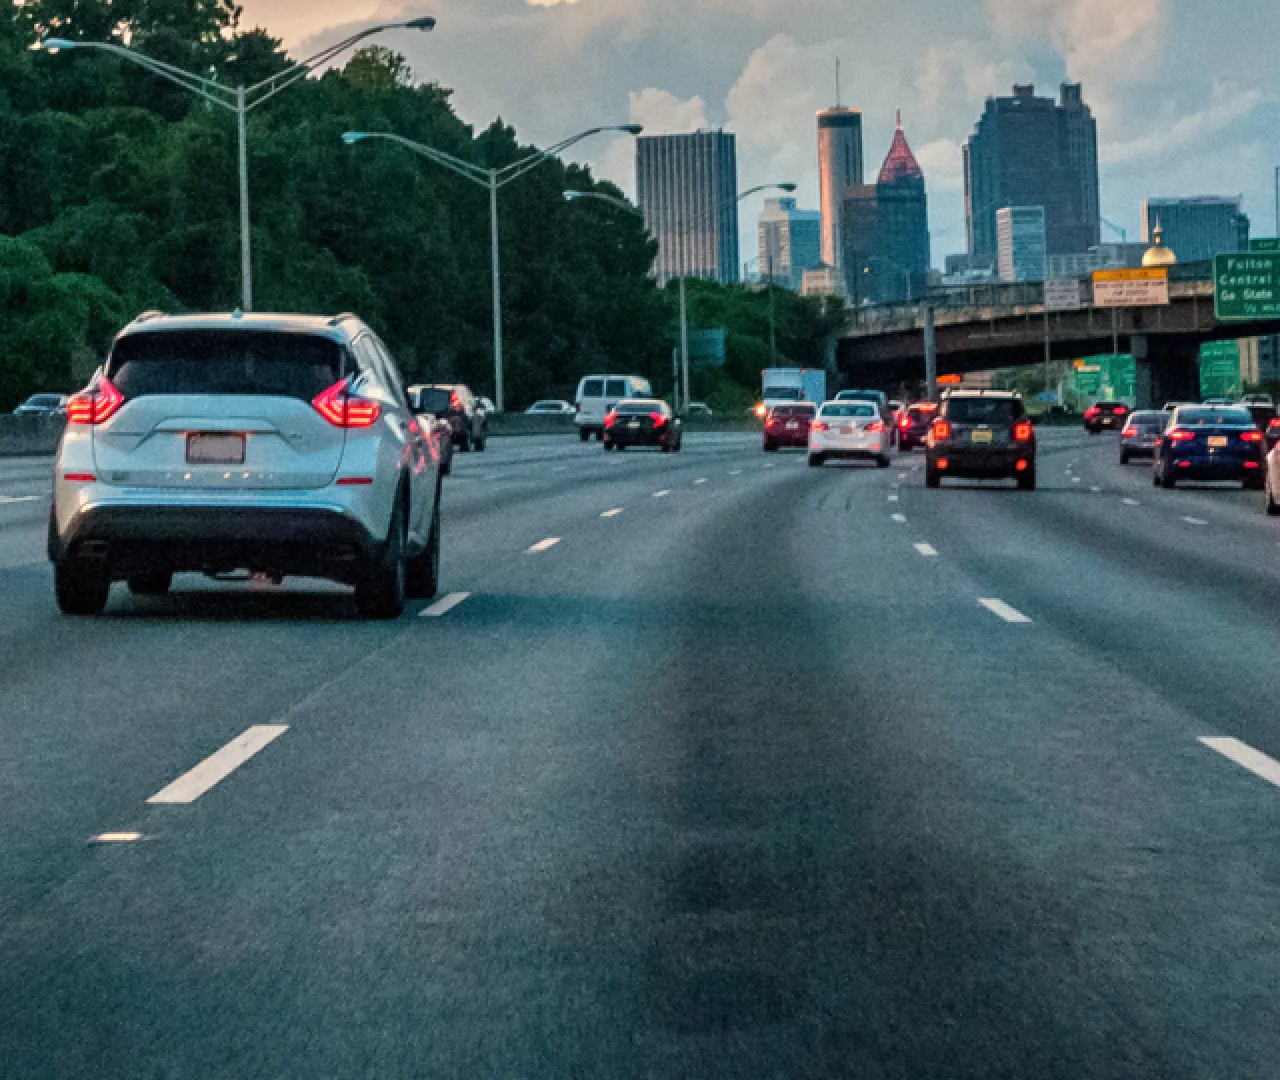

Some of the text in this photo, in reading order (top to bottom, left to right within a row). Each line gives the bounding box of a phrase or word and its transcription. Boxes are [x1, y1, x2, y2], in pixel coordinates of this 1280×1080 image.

[1227, 257, 1273, 270] Fulton
[1220, 272, 1271, 286] Central
[1243, 288, 1273, 300] State
